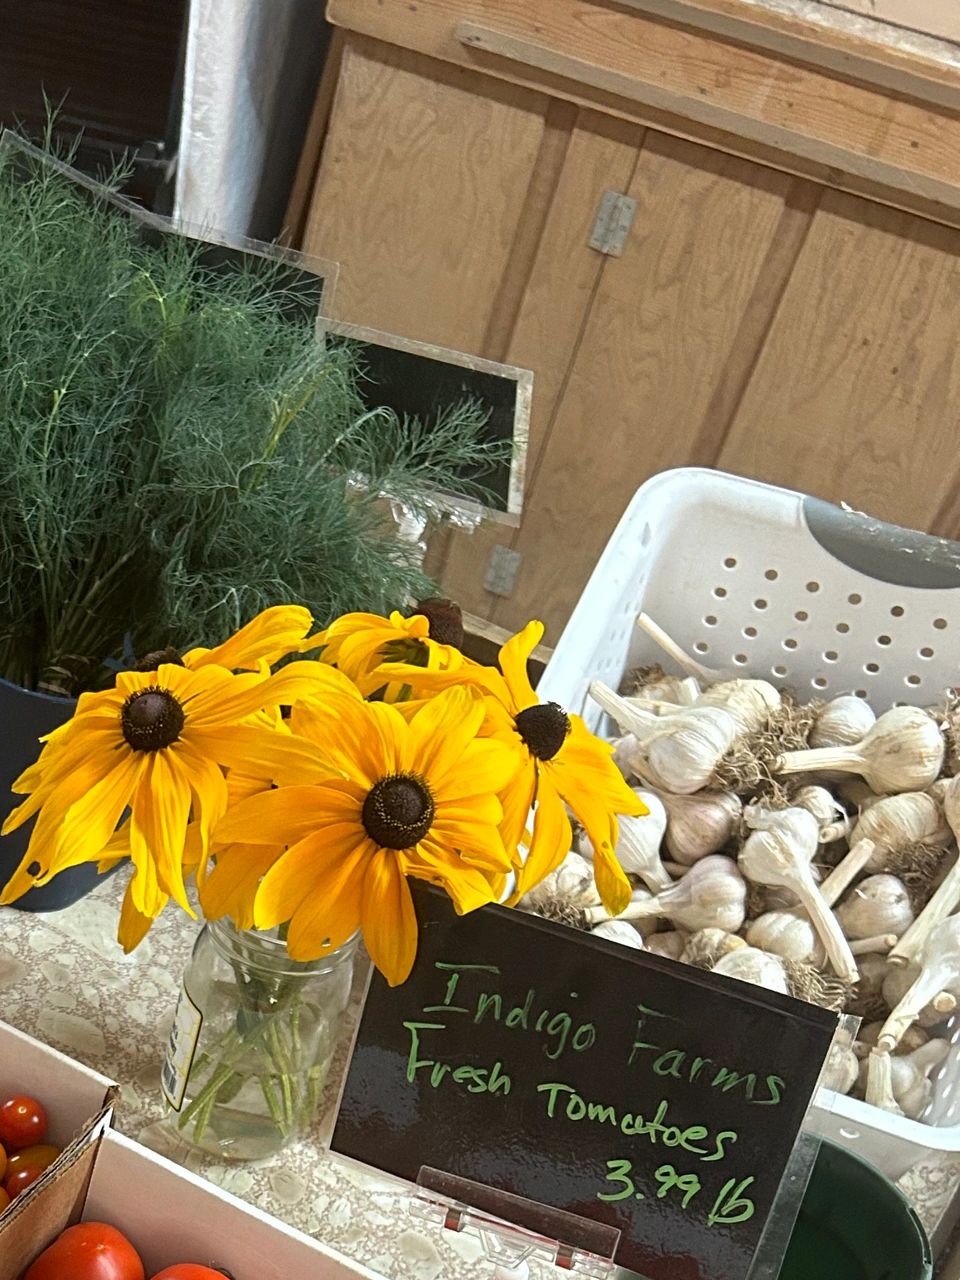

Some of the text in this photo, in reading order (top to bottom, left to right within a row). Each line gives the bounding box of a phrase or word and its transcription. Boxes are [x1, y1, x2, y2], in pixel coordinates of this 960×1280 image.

[402, 1021, 738, 1161] Fresh Tomatoes
[423, 961, 788, 1106] Indigo Farms
[596, 1159, 701, 1210] 3.99
